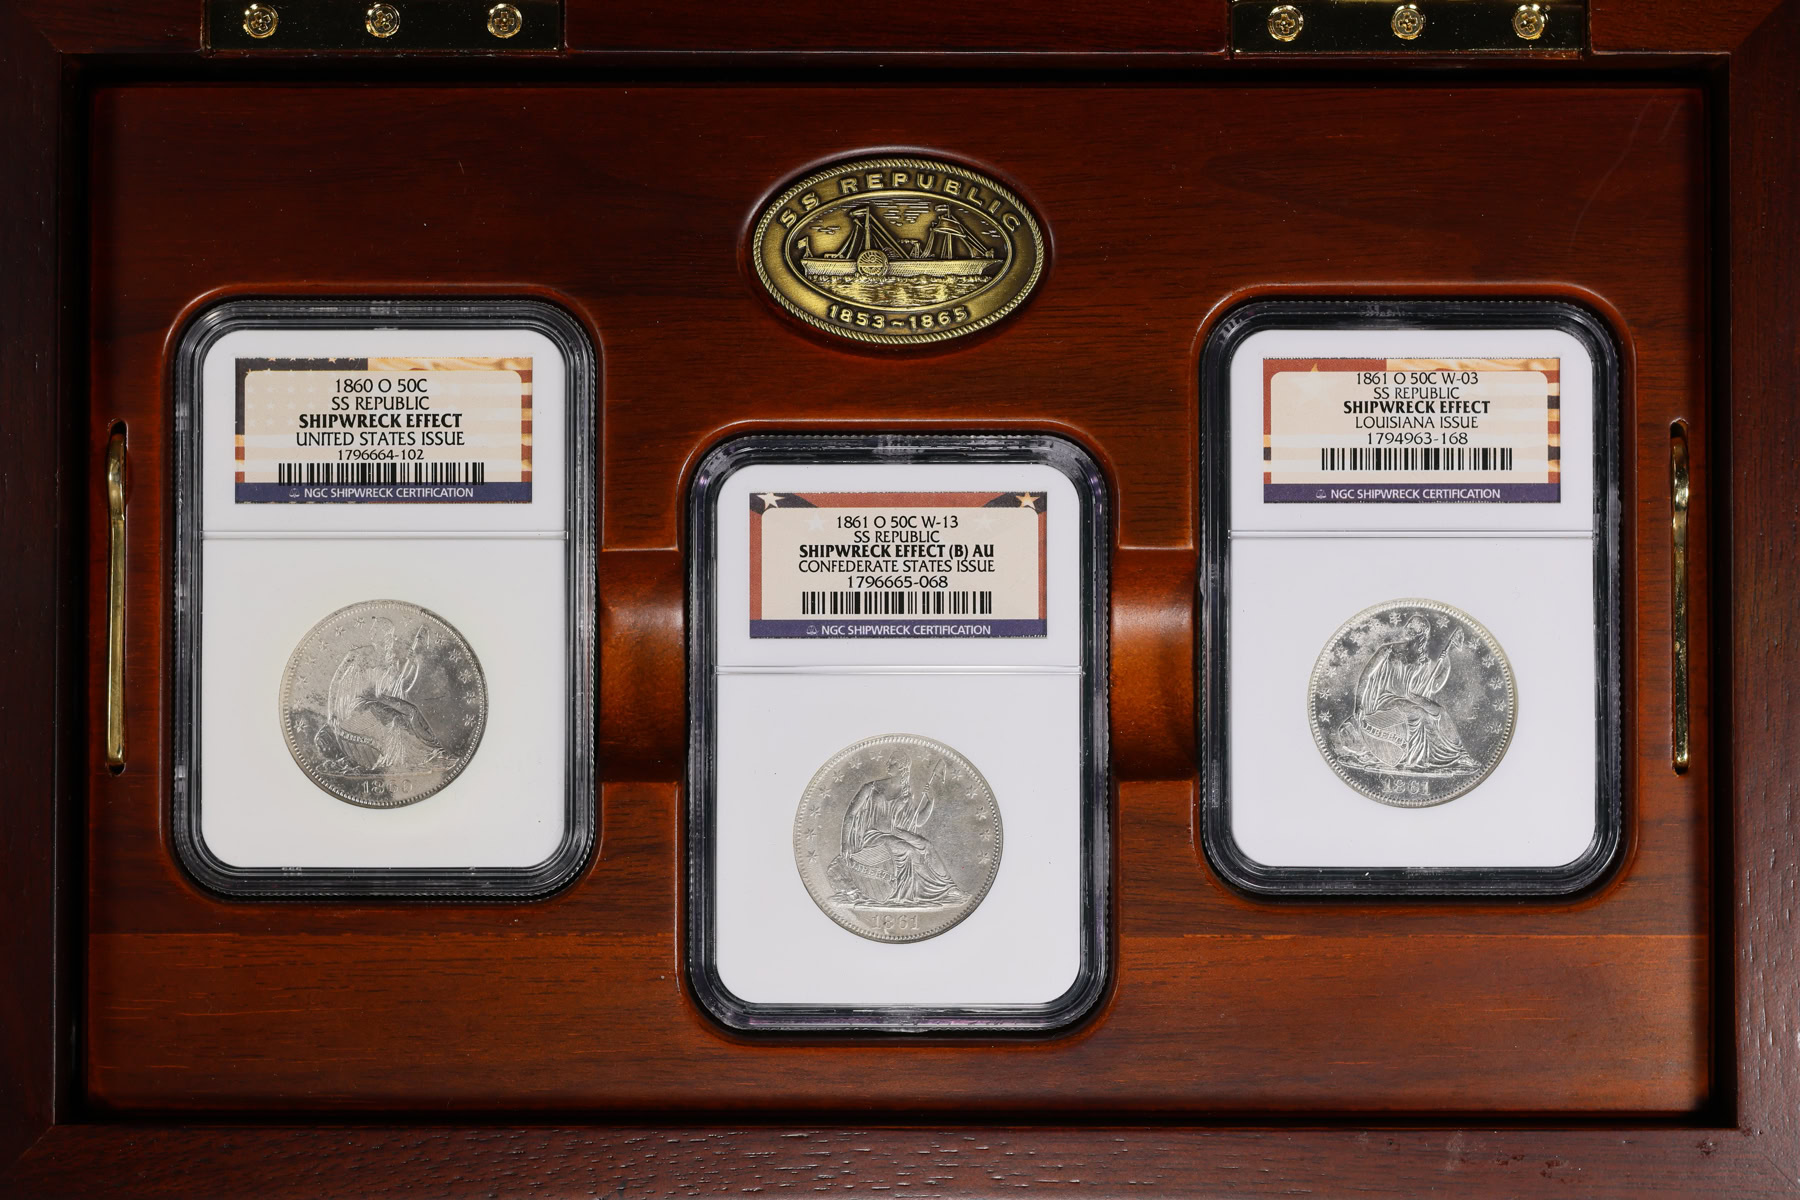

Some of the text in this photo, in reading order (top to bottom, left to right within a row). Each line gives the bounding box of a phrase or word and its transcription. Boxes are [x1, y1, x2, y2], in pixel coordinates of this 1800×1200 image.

[779, 172, 1021, 233] SS REPUBLIC
[1356, 371, 1387, 386] 1861
[1410, 371, 1437, 385] 50C
[1441, 371, 1479, 385] W-03
[335, 378, 374, 394] 1860
[397, 378, 428, 393] 50C
[1373, 386, 1460, 400] SS REPUBLIC
[331, 395, 430, 411] SS REPUBLIC
[1343, 400, 1491, 415] SHIPWRECK EFFECT
[298, 412, 463, 429] SHIPWRECK EFFECT
[1355, 415, 1479, 429] LOUISIANA ISSUE
[296, 430, 465, 447] UNITED STATES ISSUE
[1367, 431, 1469, 445] 1794963-168
[338, 448, 425, 461] 1796664-102
[304, 487, 474, 498] NGC SHIPWRECK CERTIFICATION
[1330, 488, 1501, 500] NGC SHIPWRECK CERTIFICATION
[837, 515, 868, 529] 1861
[890, 515, 918, 529] 50C
[920, 515, 959, 529] W-13
[853, 530, 941, 544] SS REPUBLIC
[799, 543, 995, 561] SHIPWRECK EFFECT (B) AU
[798, 559, 996, 573] CONFEDERATE STATES ISSUE
[847, 575, 949, 589] 1796665-068
[821, 624, 991, 636] NGC SHIPWRECK CERTIFICATION
[361, 778, 413, 794] 1860
[1382, 777, 1431, 796] 1861
[870, 914, 921, 931] 1861
